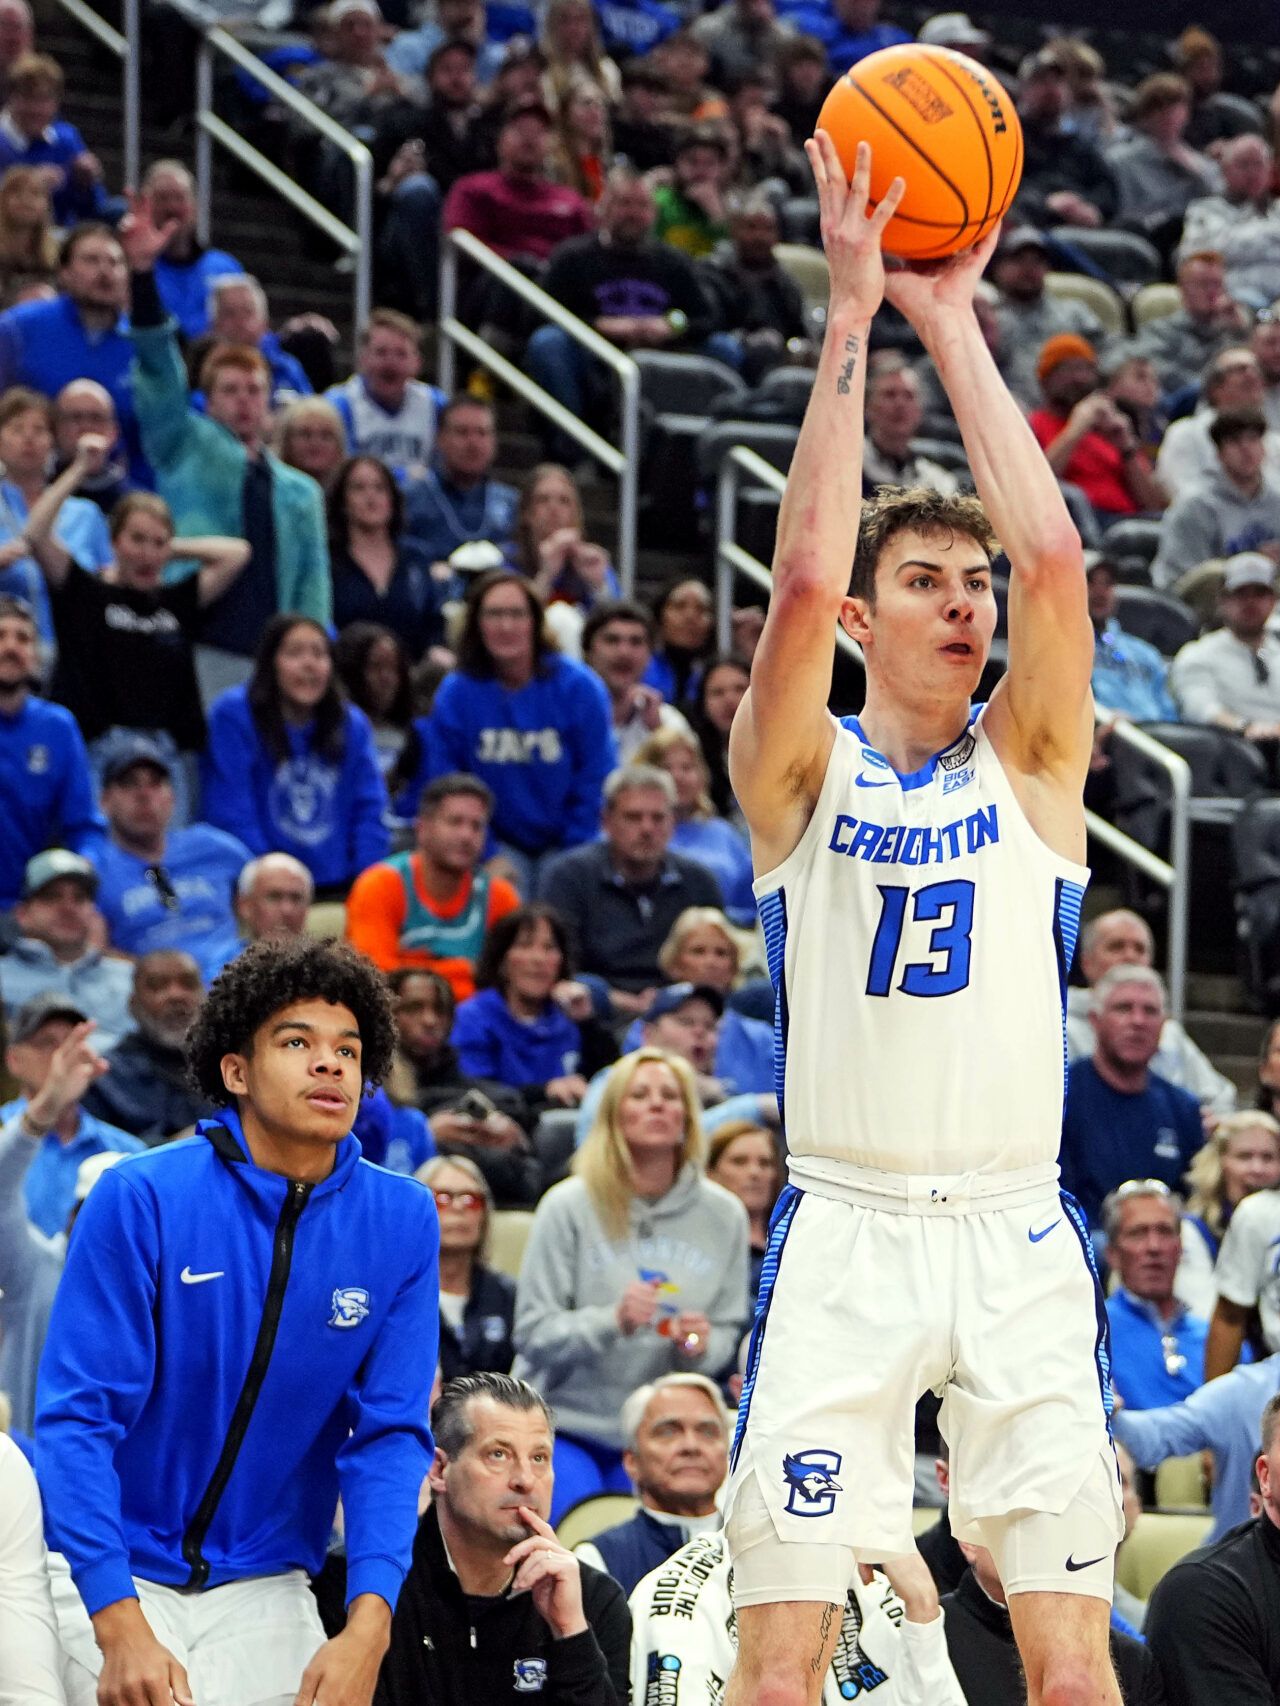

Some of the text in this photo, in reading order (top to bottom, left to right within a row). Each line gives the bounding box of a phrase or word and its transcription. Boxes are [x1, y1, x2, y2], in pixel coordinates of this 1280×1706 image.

[944, 768, 968, 781] BIG
[828, 804, 999, 865] CREIGHTON
[865, 879, 975, 997] 13
[659, 1671, 677, 1706] MAR
